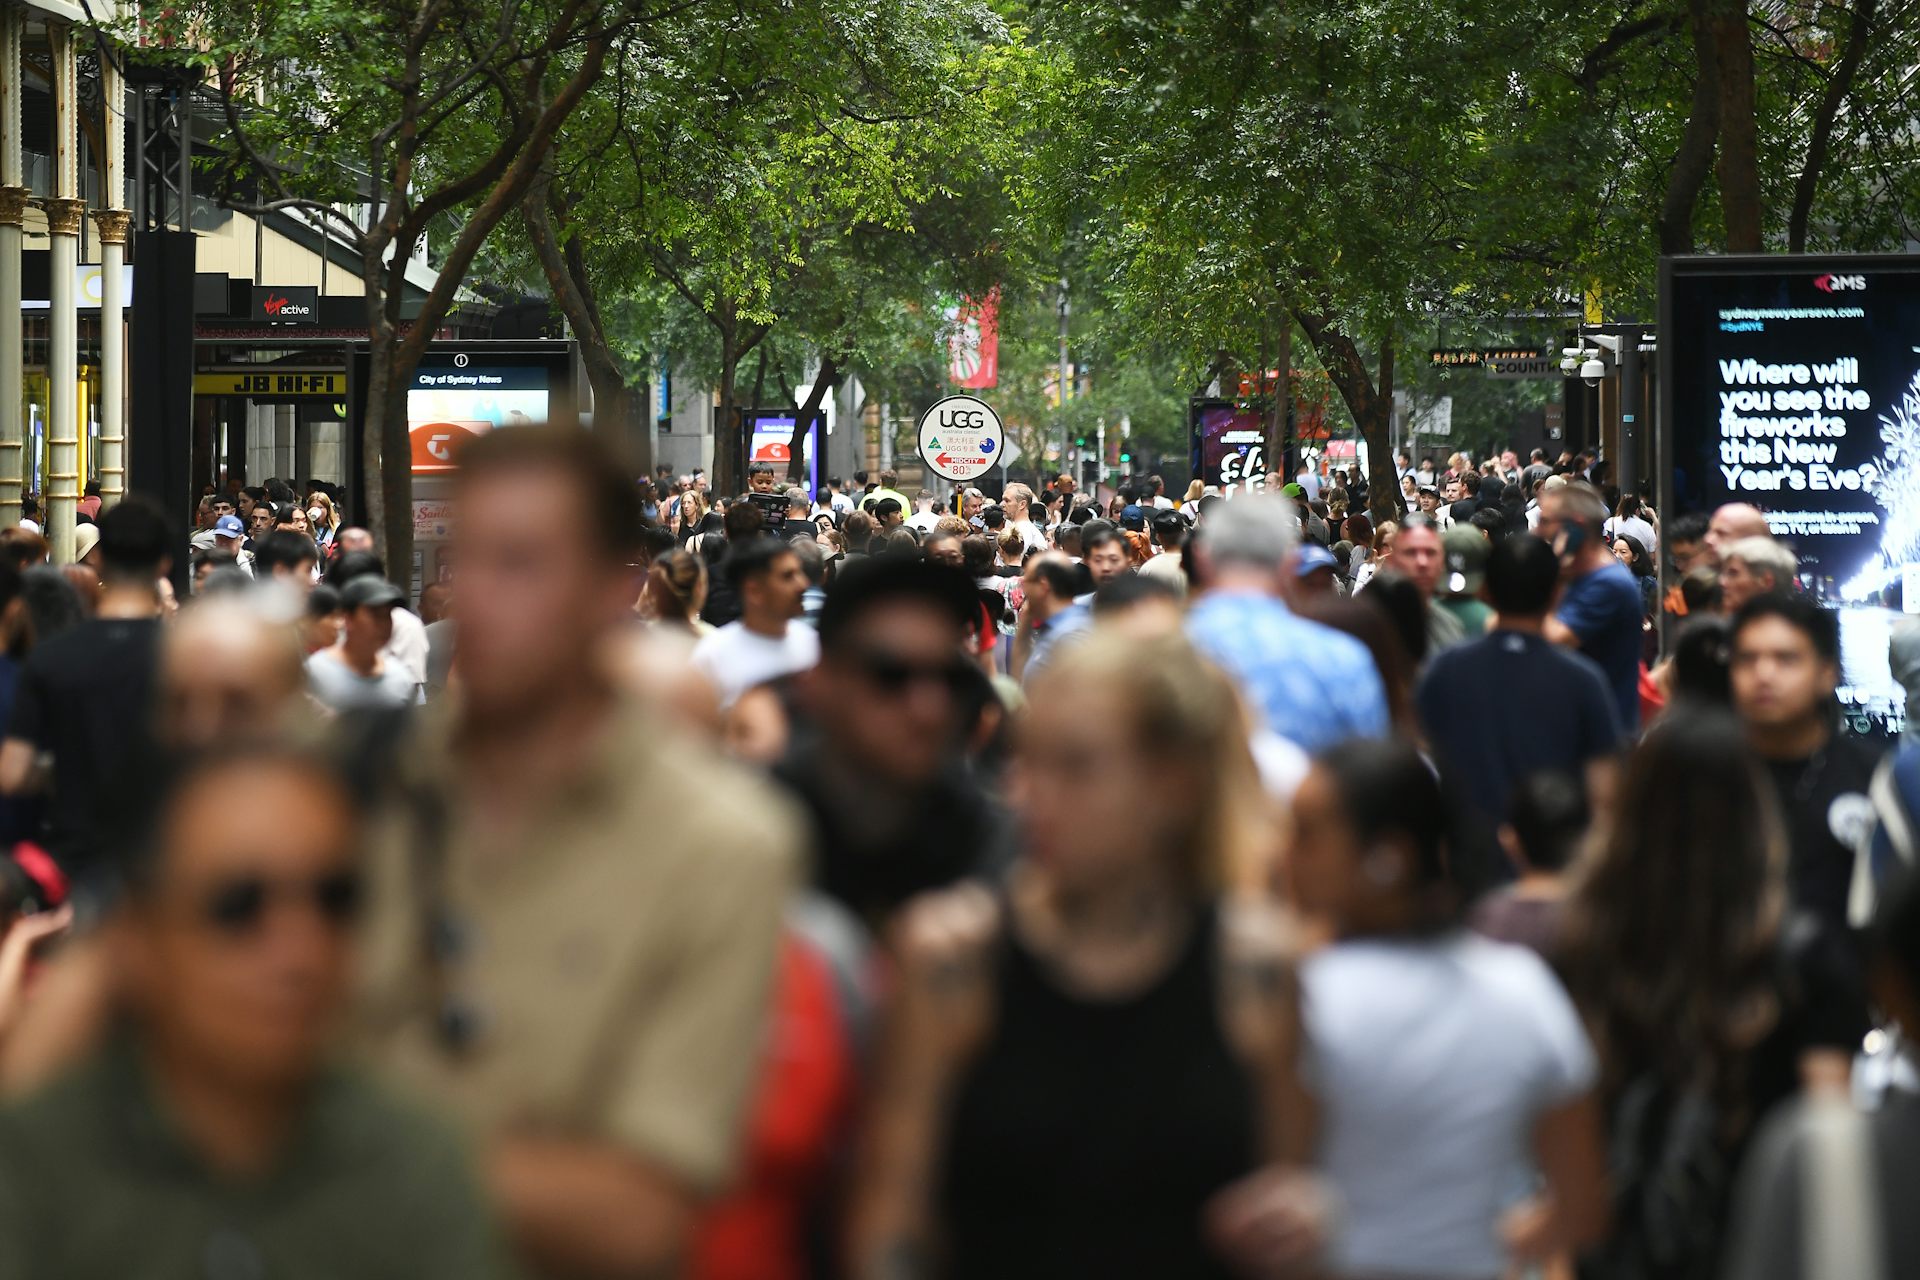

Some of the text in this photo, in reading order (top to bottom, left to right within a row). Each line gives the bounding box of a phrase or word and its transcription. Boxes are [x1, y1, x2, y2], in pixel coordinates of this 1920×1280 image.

[281, 305, 309, 314] active
[234, 376, 270, 392] JB
[419, 375, 502, 385] City of Sydney News
[1719, 357, 1859, 384] Where will
[1719, 383, 1871, 414] you see the
[940, 410, 984, 428] UGG
[1719, 408, 1847, 437] fireworks
[1719, 437, 1838, 464] this New
[1719, 462, 1877, 493] Year's Eve?
